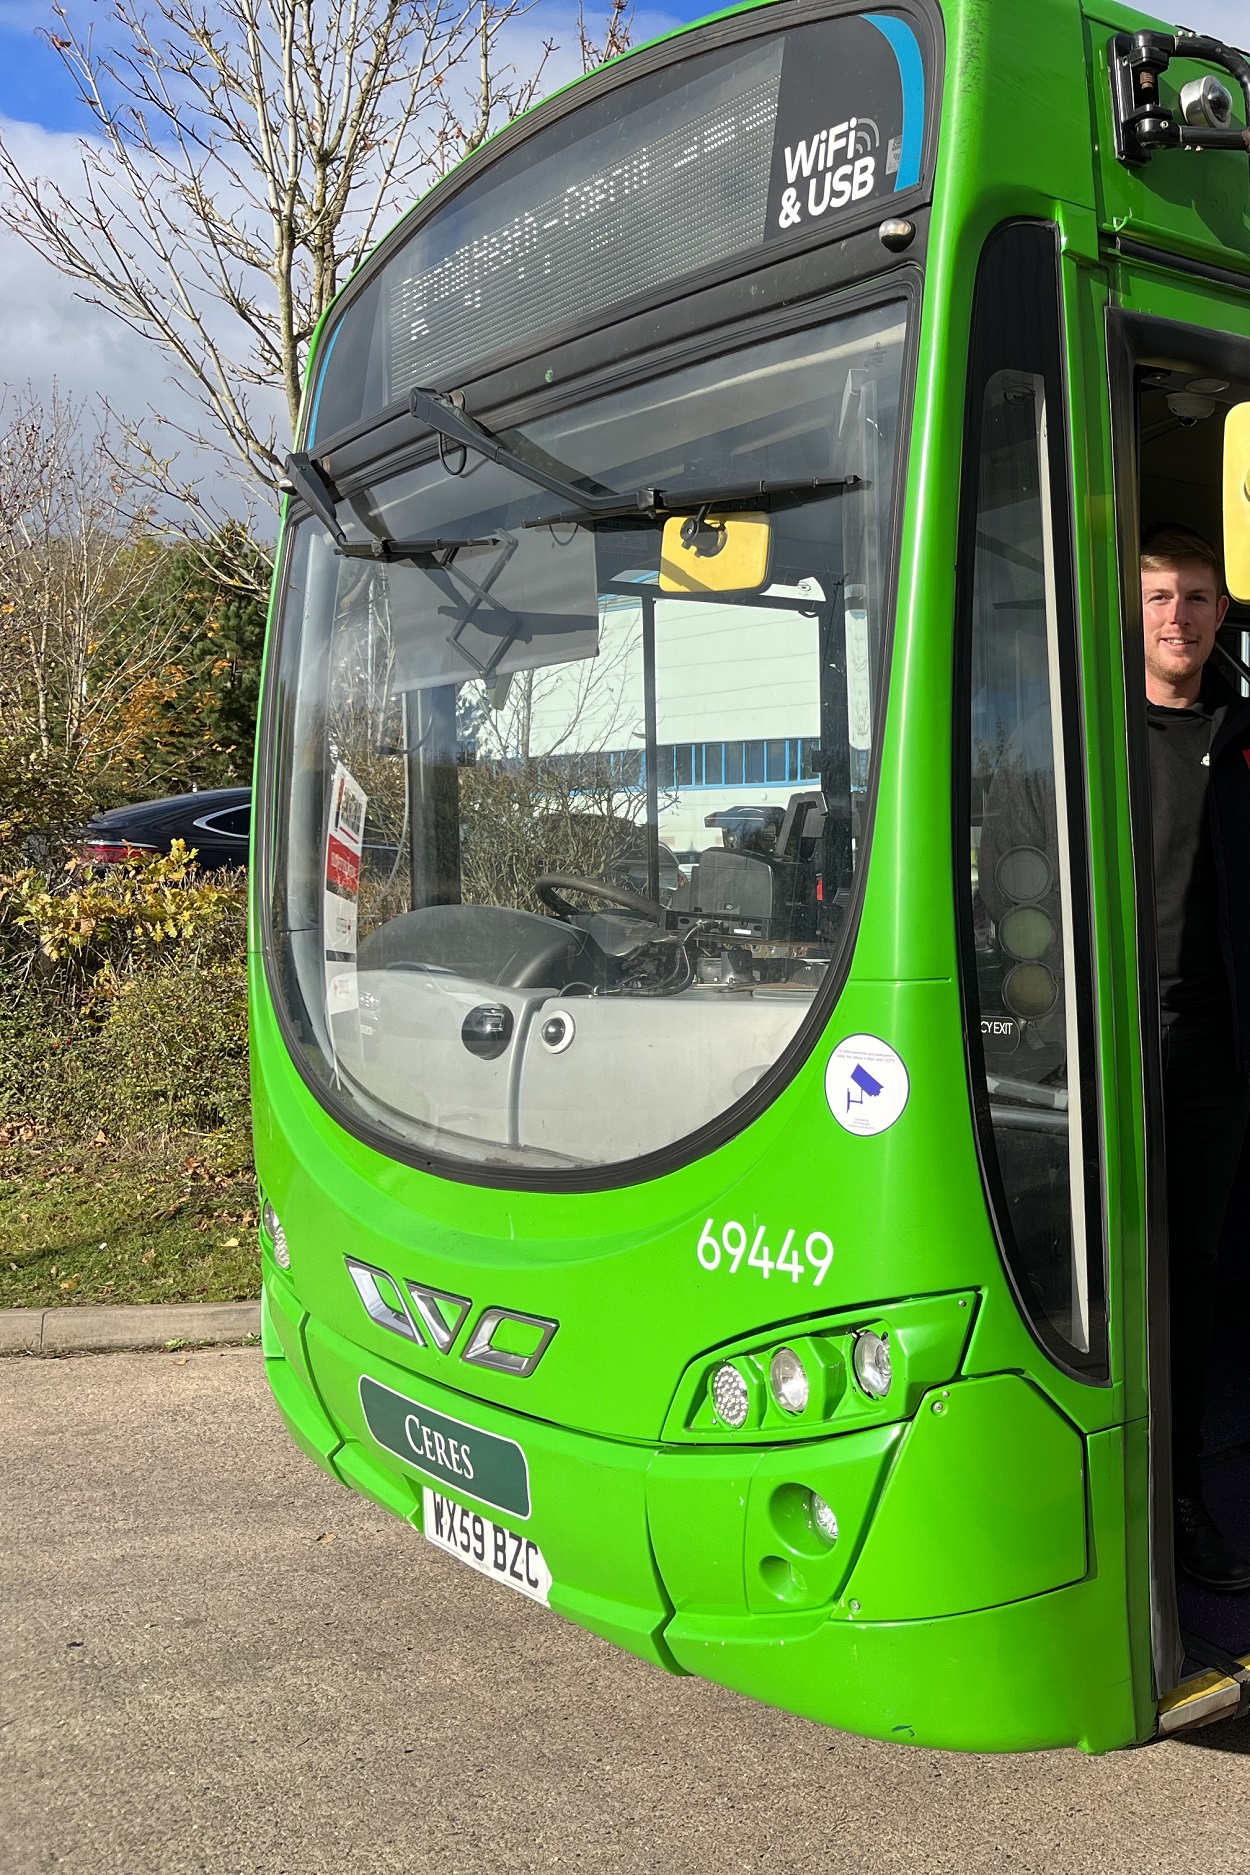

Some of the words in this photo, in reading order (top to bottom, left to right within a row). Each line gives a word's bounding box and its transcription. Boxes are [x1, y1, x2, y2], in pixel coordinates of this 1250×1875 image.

[784, 117, 857, 184] WiFi
[779, 187, 801, 229] &
[808, 156, 875, 216] USB
[994, 1021, 1013, 1035] EXIT
[697, 1218, 834, 1286] 69449
[405, 1414, 474, 1480] CERES
[433, 1491, 485, 1562] WX59
[493, 1523, 539, 1589] BZC
